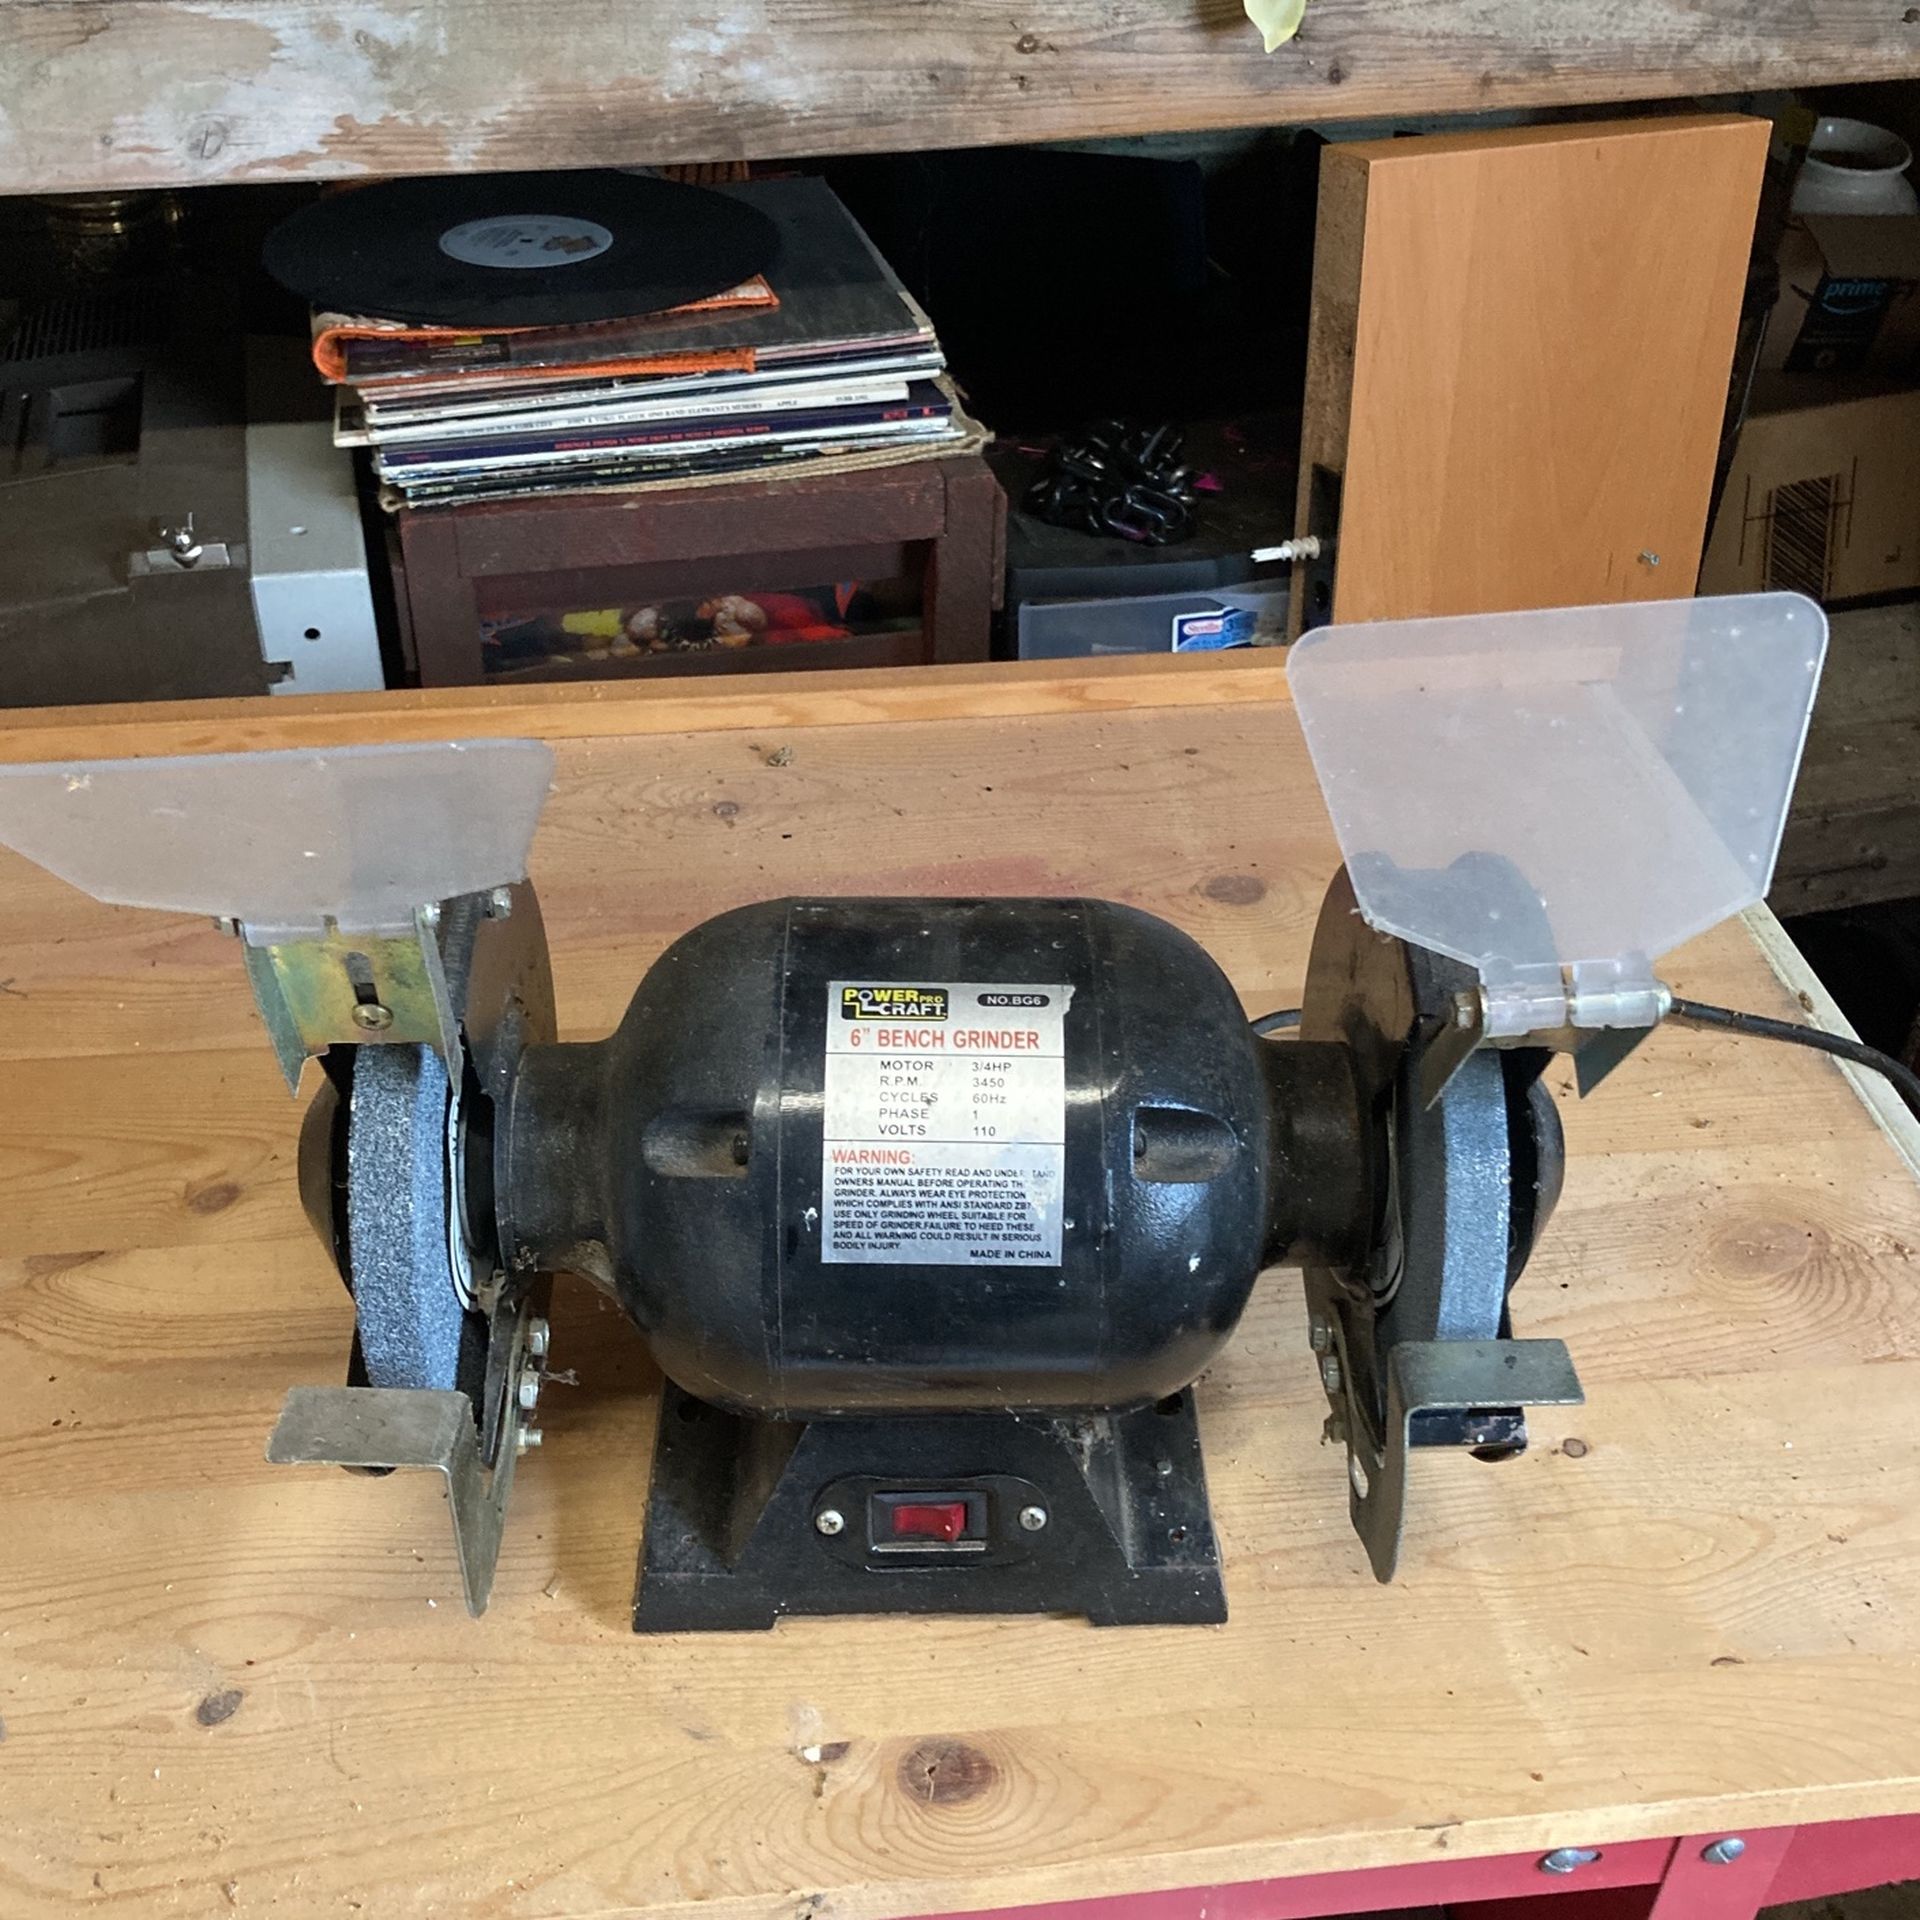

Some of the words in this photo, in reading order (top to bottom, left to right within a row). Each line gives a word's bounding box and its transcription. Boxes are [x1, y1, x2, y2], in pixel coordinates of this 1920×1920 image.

[1824, 282, 1888, 301] prime
[844, 989, 919, 1003] POWER
[919, 995, 943, 1004] PRO
[987, 995, 1042, 1006] NO.BG6
[880, 1003, 945, 1016] CRAFT
[878, 1029, 944, 1048] BENCH
[953, 1030, 1040, 1049] GRINDER
[880, 1060, 934, 1071] MOTOR
[972, 1062, 1012, 1072] 3/4HP
[880, 1076, 921, 1086] R.P.M.
[972, 1077, 1005, 1088] 3450
[879, 1092, 939, 1104] CYCLES
[972, 1094, 1007, 1104] 60Hz
[879, 1108, 930, 1119] PHASE
[973, 1110, 979, 1120] 1
[878, 1124, 927, 1135] VOLTS
[973, 1126, 996, 1137] 110
[832, 1149, 915, 1165] WARNING:
[834, 1166, 853, 1175] FOR
[856, 1166, 881, 1176] YOUR
[884, 1167, 905, 1176] OWN
[908, 1167, 942, 1176] SAFETY
[945, 1168, 971, 1177] READ
[972, 1169, 992, 1178] AND
[834, 1178, 874, 1186] OWNERS
[876, 1178, 915, 1187] MANUAL
[917, 1179, 954, 1188] BEFORE
[956, 1180, 1008, 1188] OPERATING
[880, 1189, 916, 1197] ALWAYS
[919, 1190, 946, 1198] WEAR
[948, 1190, 966, 1199] EYE
[968, 1190, 1027, 1199] PROTECTION
[834, 1200, 864, 1208] WHICH
[866, 1200, 913, 1208] COMPLIES
[915, 1200, 937, 1208] WITH
[940, 1201, 961, 1209] ANSI
[963, 1201, 1013, 1210] STANDARD
[833, 1210, 851, 1218] USE
[854, 1210, 878, 1219] ONLY
[880, 1210, 925, 1219] GRINDING
[927, 1211, 959, 1220] WHEEL
[961, 1211, 1005, 1220] SUITABLE
[1007, 1212, 1026, 1220] FOR
[833, 1221, 863, 1229] SPEED
[865, 1221, 878, 1229] OF
[964, 1222, 976, 1230] TO
[979, 1222, 1004, 1231] HEED
[1006, 1223, 1035, 1231] THESE
[874, 1232, 917, 1240] WARNING
[920, 1232, 951, 1240] COULD
[953, 1233, 988, 1241] RESULT
[990, 1233, 1000, 1241] IN
[1001, 1233, 1042, 1242] SERIOUS
[833, 1241, 866, 1250] BODILY
[970, 1250, 1002, 1259] MADE
[1004, 1250, 1016, 1259] IN
[1018, 1251, 1053, 1260] CHINA
